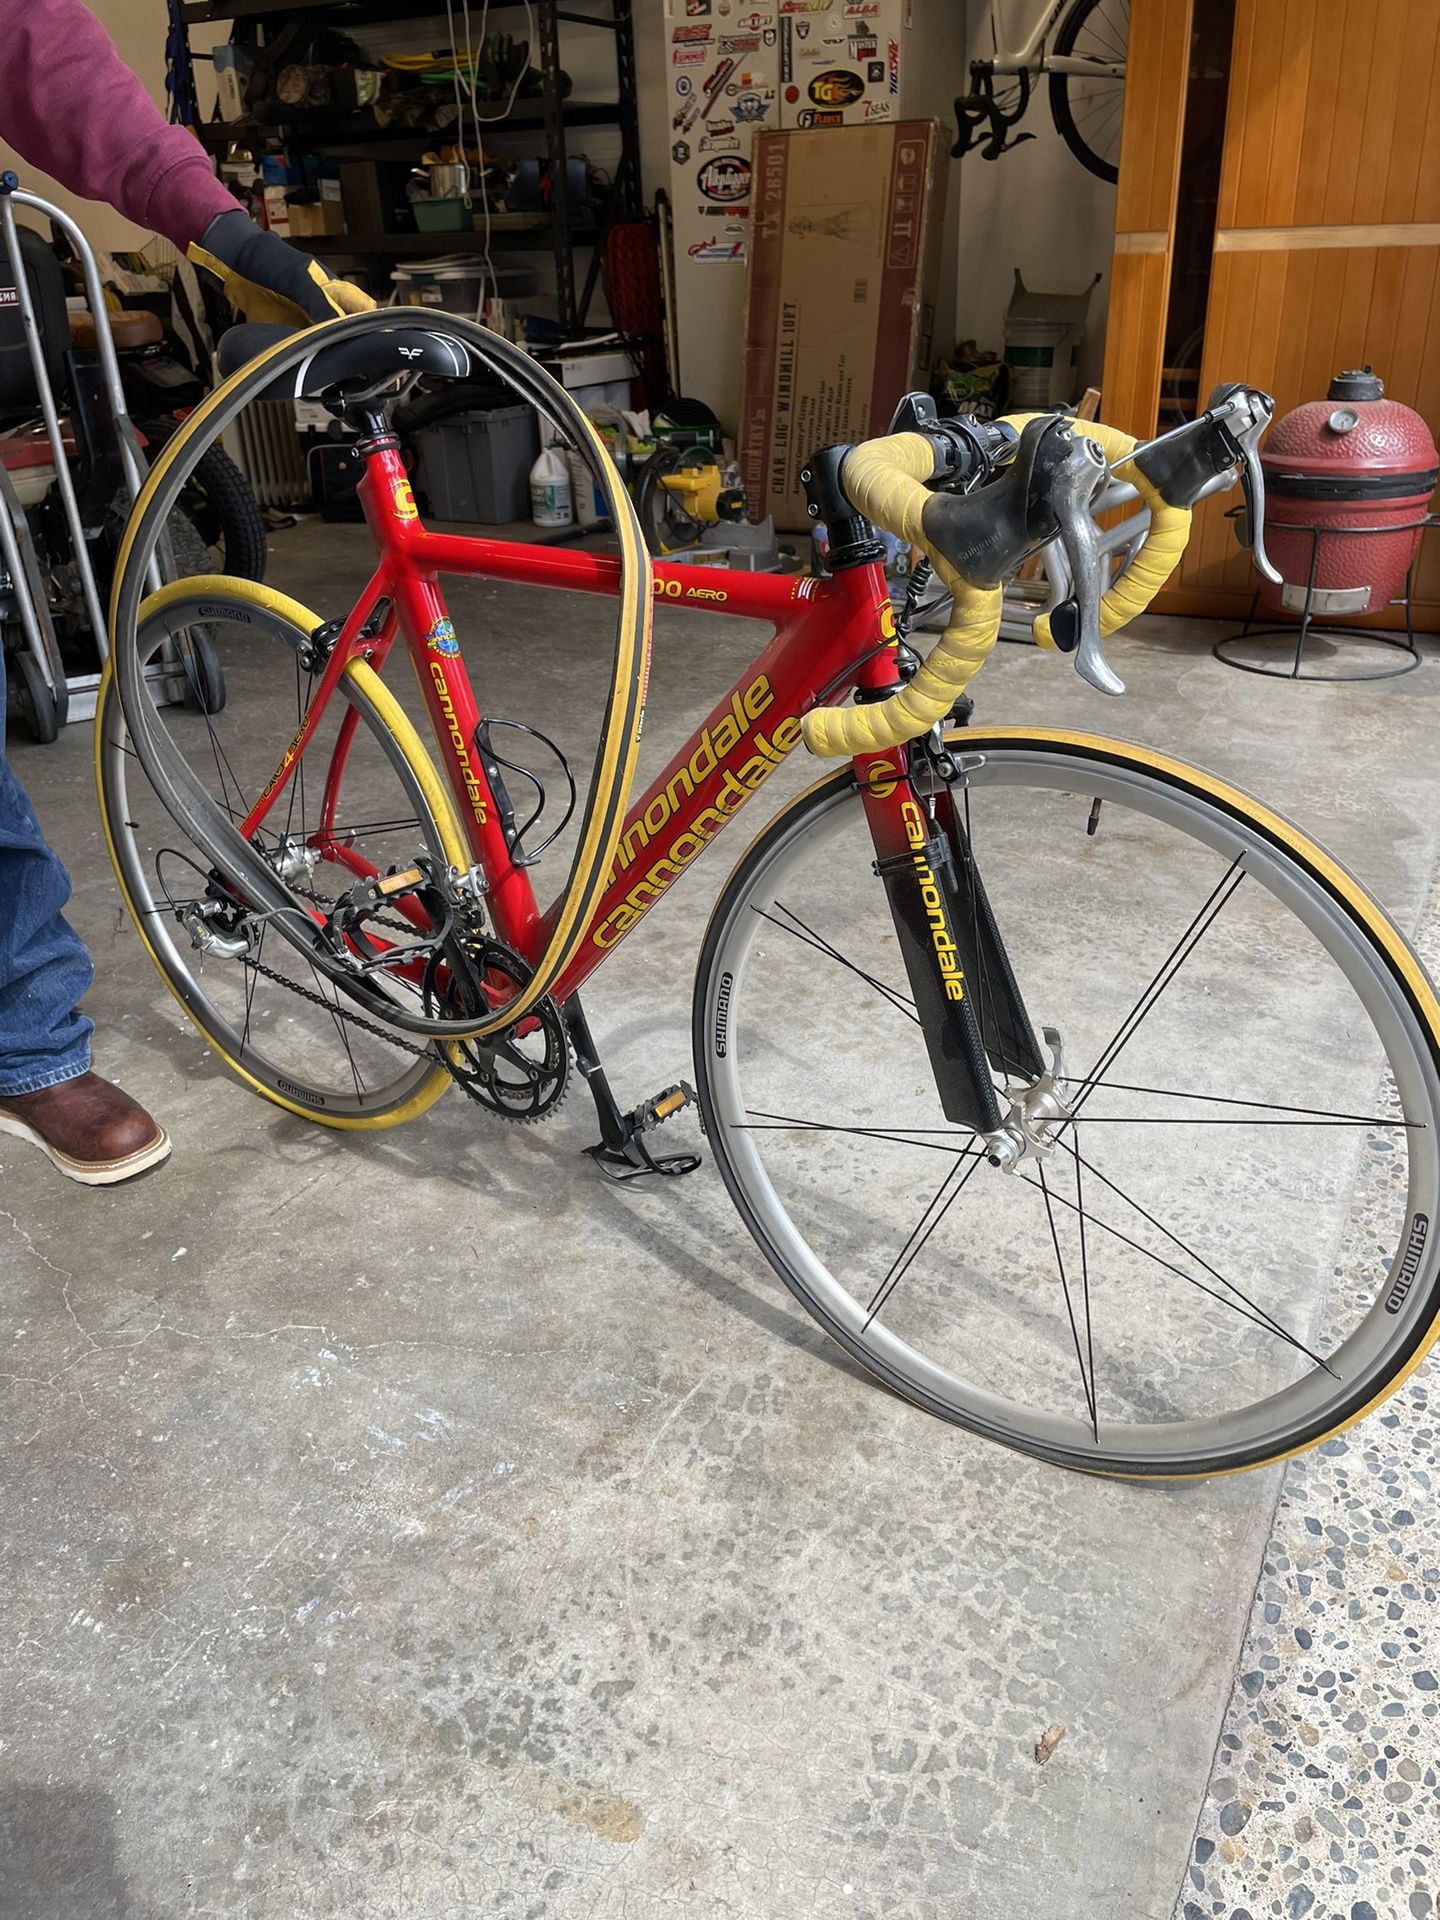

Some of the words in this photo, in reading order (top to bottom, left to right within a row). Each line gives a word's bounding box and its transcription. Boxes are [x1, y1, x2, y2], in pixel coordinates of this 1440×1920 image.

[777, 340, 794, 412] WINDMILL
[686, 587, 728, 602] AERO
[429, 662, 487, 825] cannondale
[605, 673, 775, 890] nnondale
[592, 716, 803, 949] cannondale
[717, 977, 732, 1053] SHIMANO
[280, 1080, 323, 1105] SHIMANO
[1387, 1218, 1427, 1310] SHIMANO
